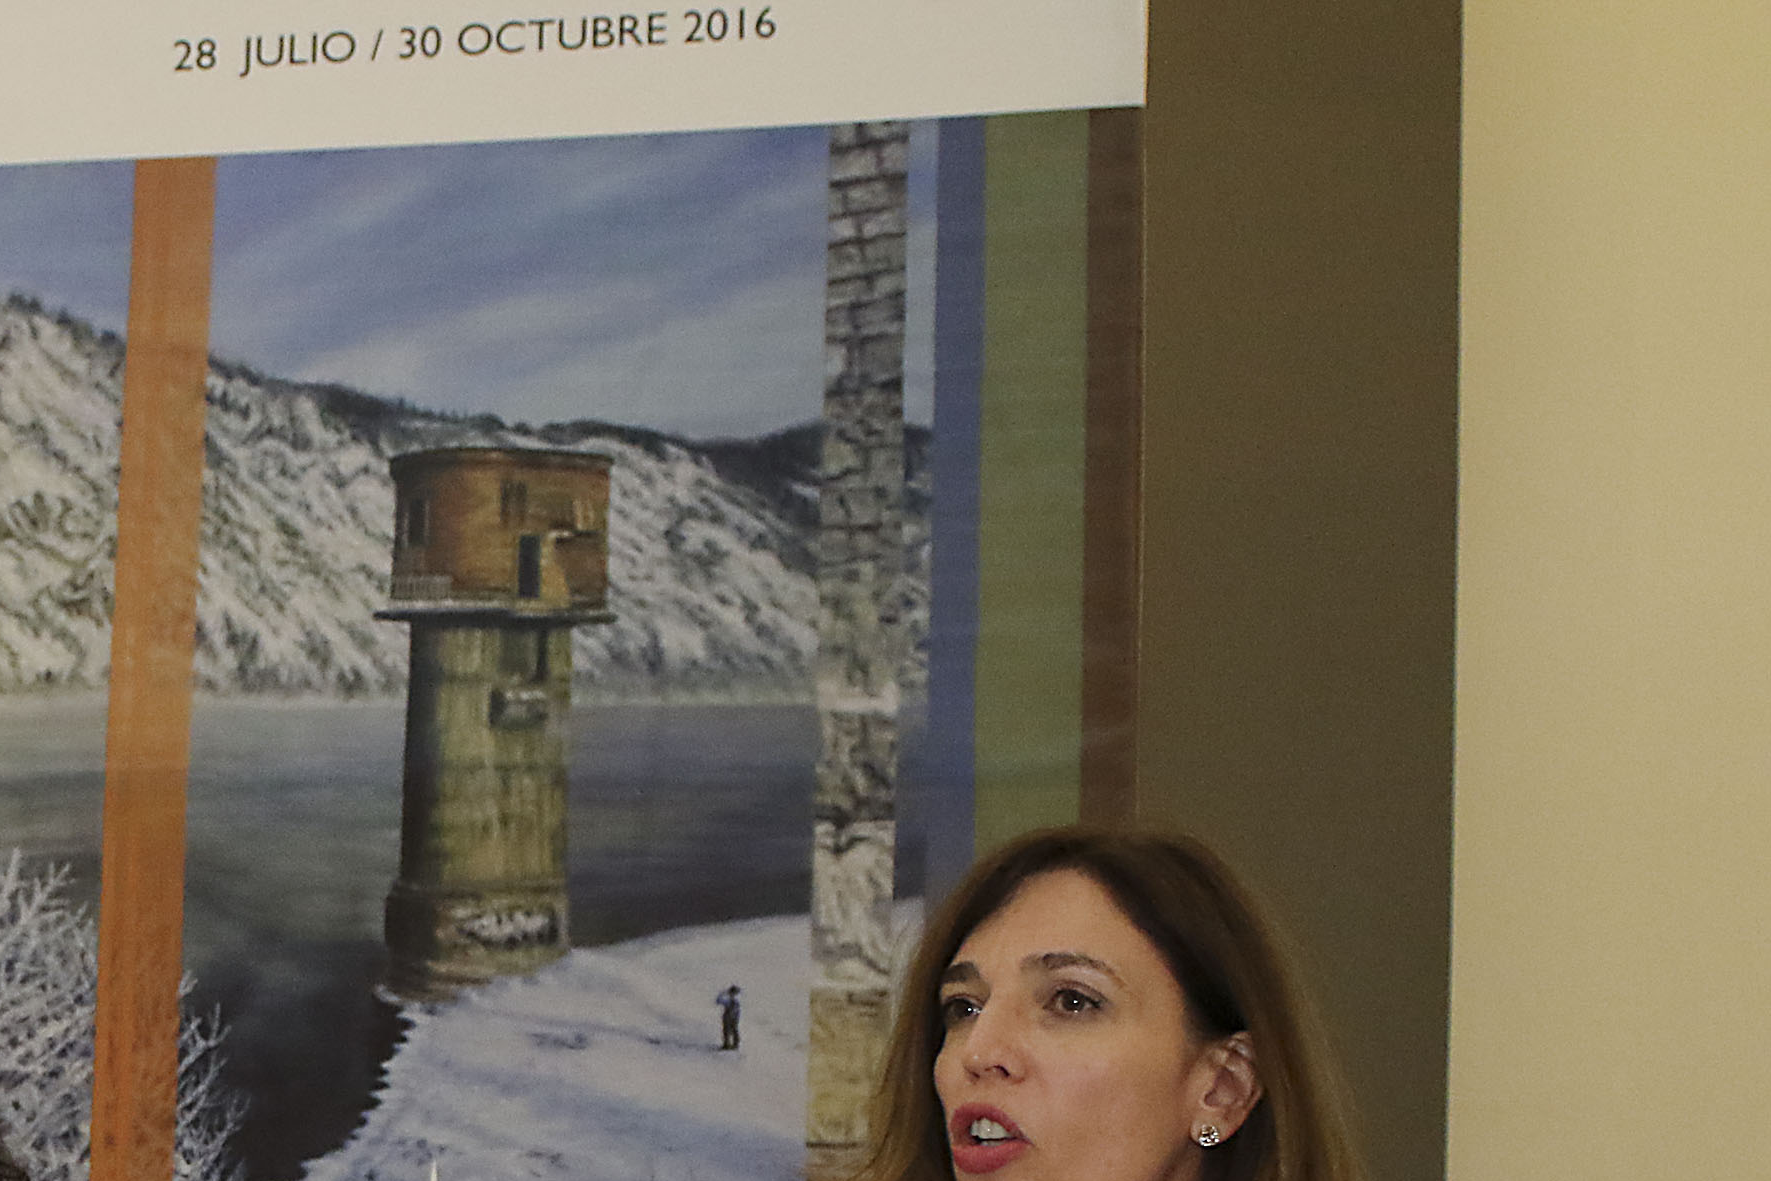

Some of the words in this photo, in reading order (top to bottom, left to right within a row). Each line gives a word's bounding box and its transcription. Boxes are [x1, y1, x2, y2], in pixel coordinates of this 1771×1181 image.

[174, 38, 216, 71] 28
[239, 31, 356, 77] JULIO
[371, 29, 383, 61] /
[399, 26, 441, 59] 30
[457, 11, 667, 55] OCTUBRE
[684, 6, 777, 42] 2016
